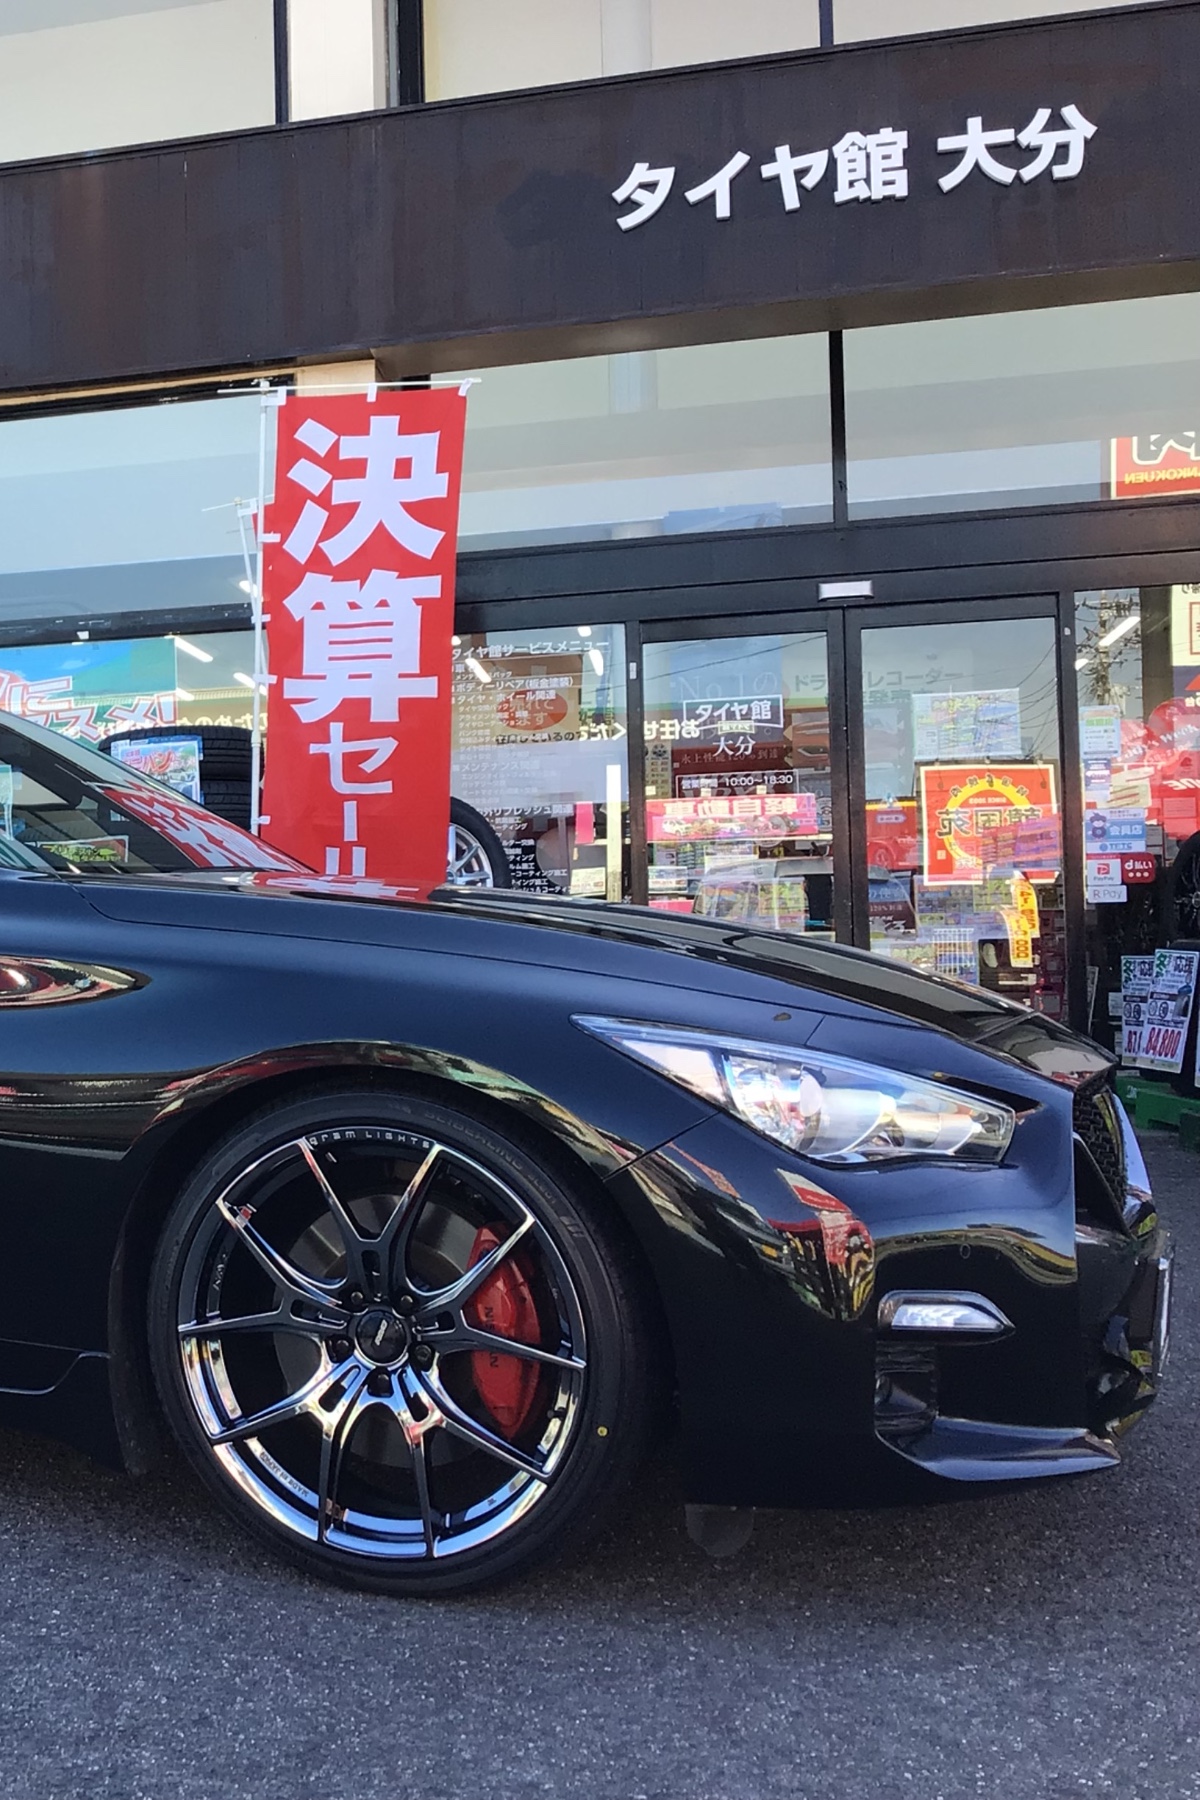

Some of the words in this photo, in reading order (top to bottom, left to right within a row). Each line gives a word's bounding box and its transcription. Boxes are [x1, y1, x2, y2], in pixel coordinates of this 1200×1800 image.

[612, 127, 908, 232] タイヤ館
[937, 104, 1098, 193] 大分
[695, 700, 772, 723] タイヤ館
[712, 736, 756, 757] 大分
[365, 1131, 430, 1148] LIGHTS
